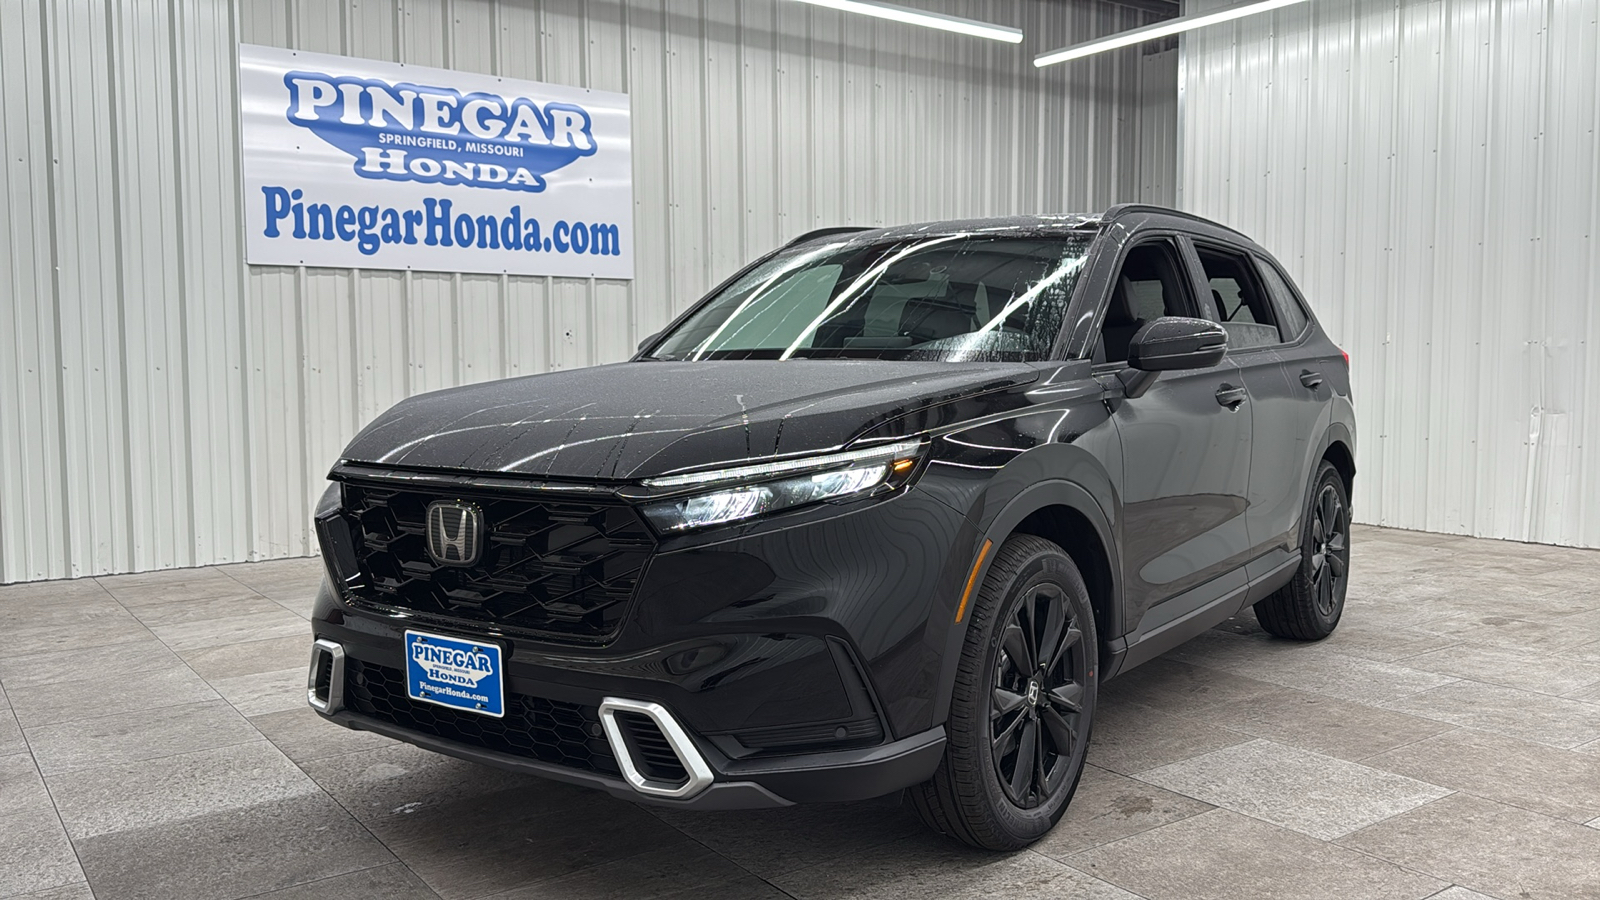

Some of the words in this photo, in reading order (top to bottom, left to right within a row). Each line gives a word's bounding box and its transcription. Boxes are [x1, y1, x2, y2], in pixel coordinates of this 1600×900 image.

[293, 78, 593, 150] PINEGAR
[378, 132, 462, 153] SPRINGFIELD,
[465, 141, 524, 158] MISSOURI
[360, 147, 541, 187] HONDA
[261, 186, 621, 256] PinegarHonda.com
[413, 644, 491, 673] PINEGAR
[419, 681, 489, 703] PinegarHonda.com
[428, 668, 476, 687] HONDA
